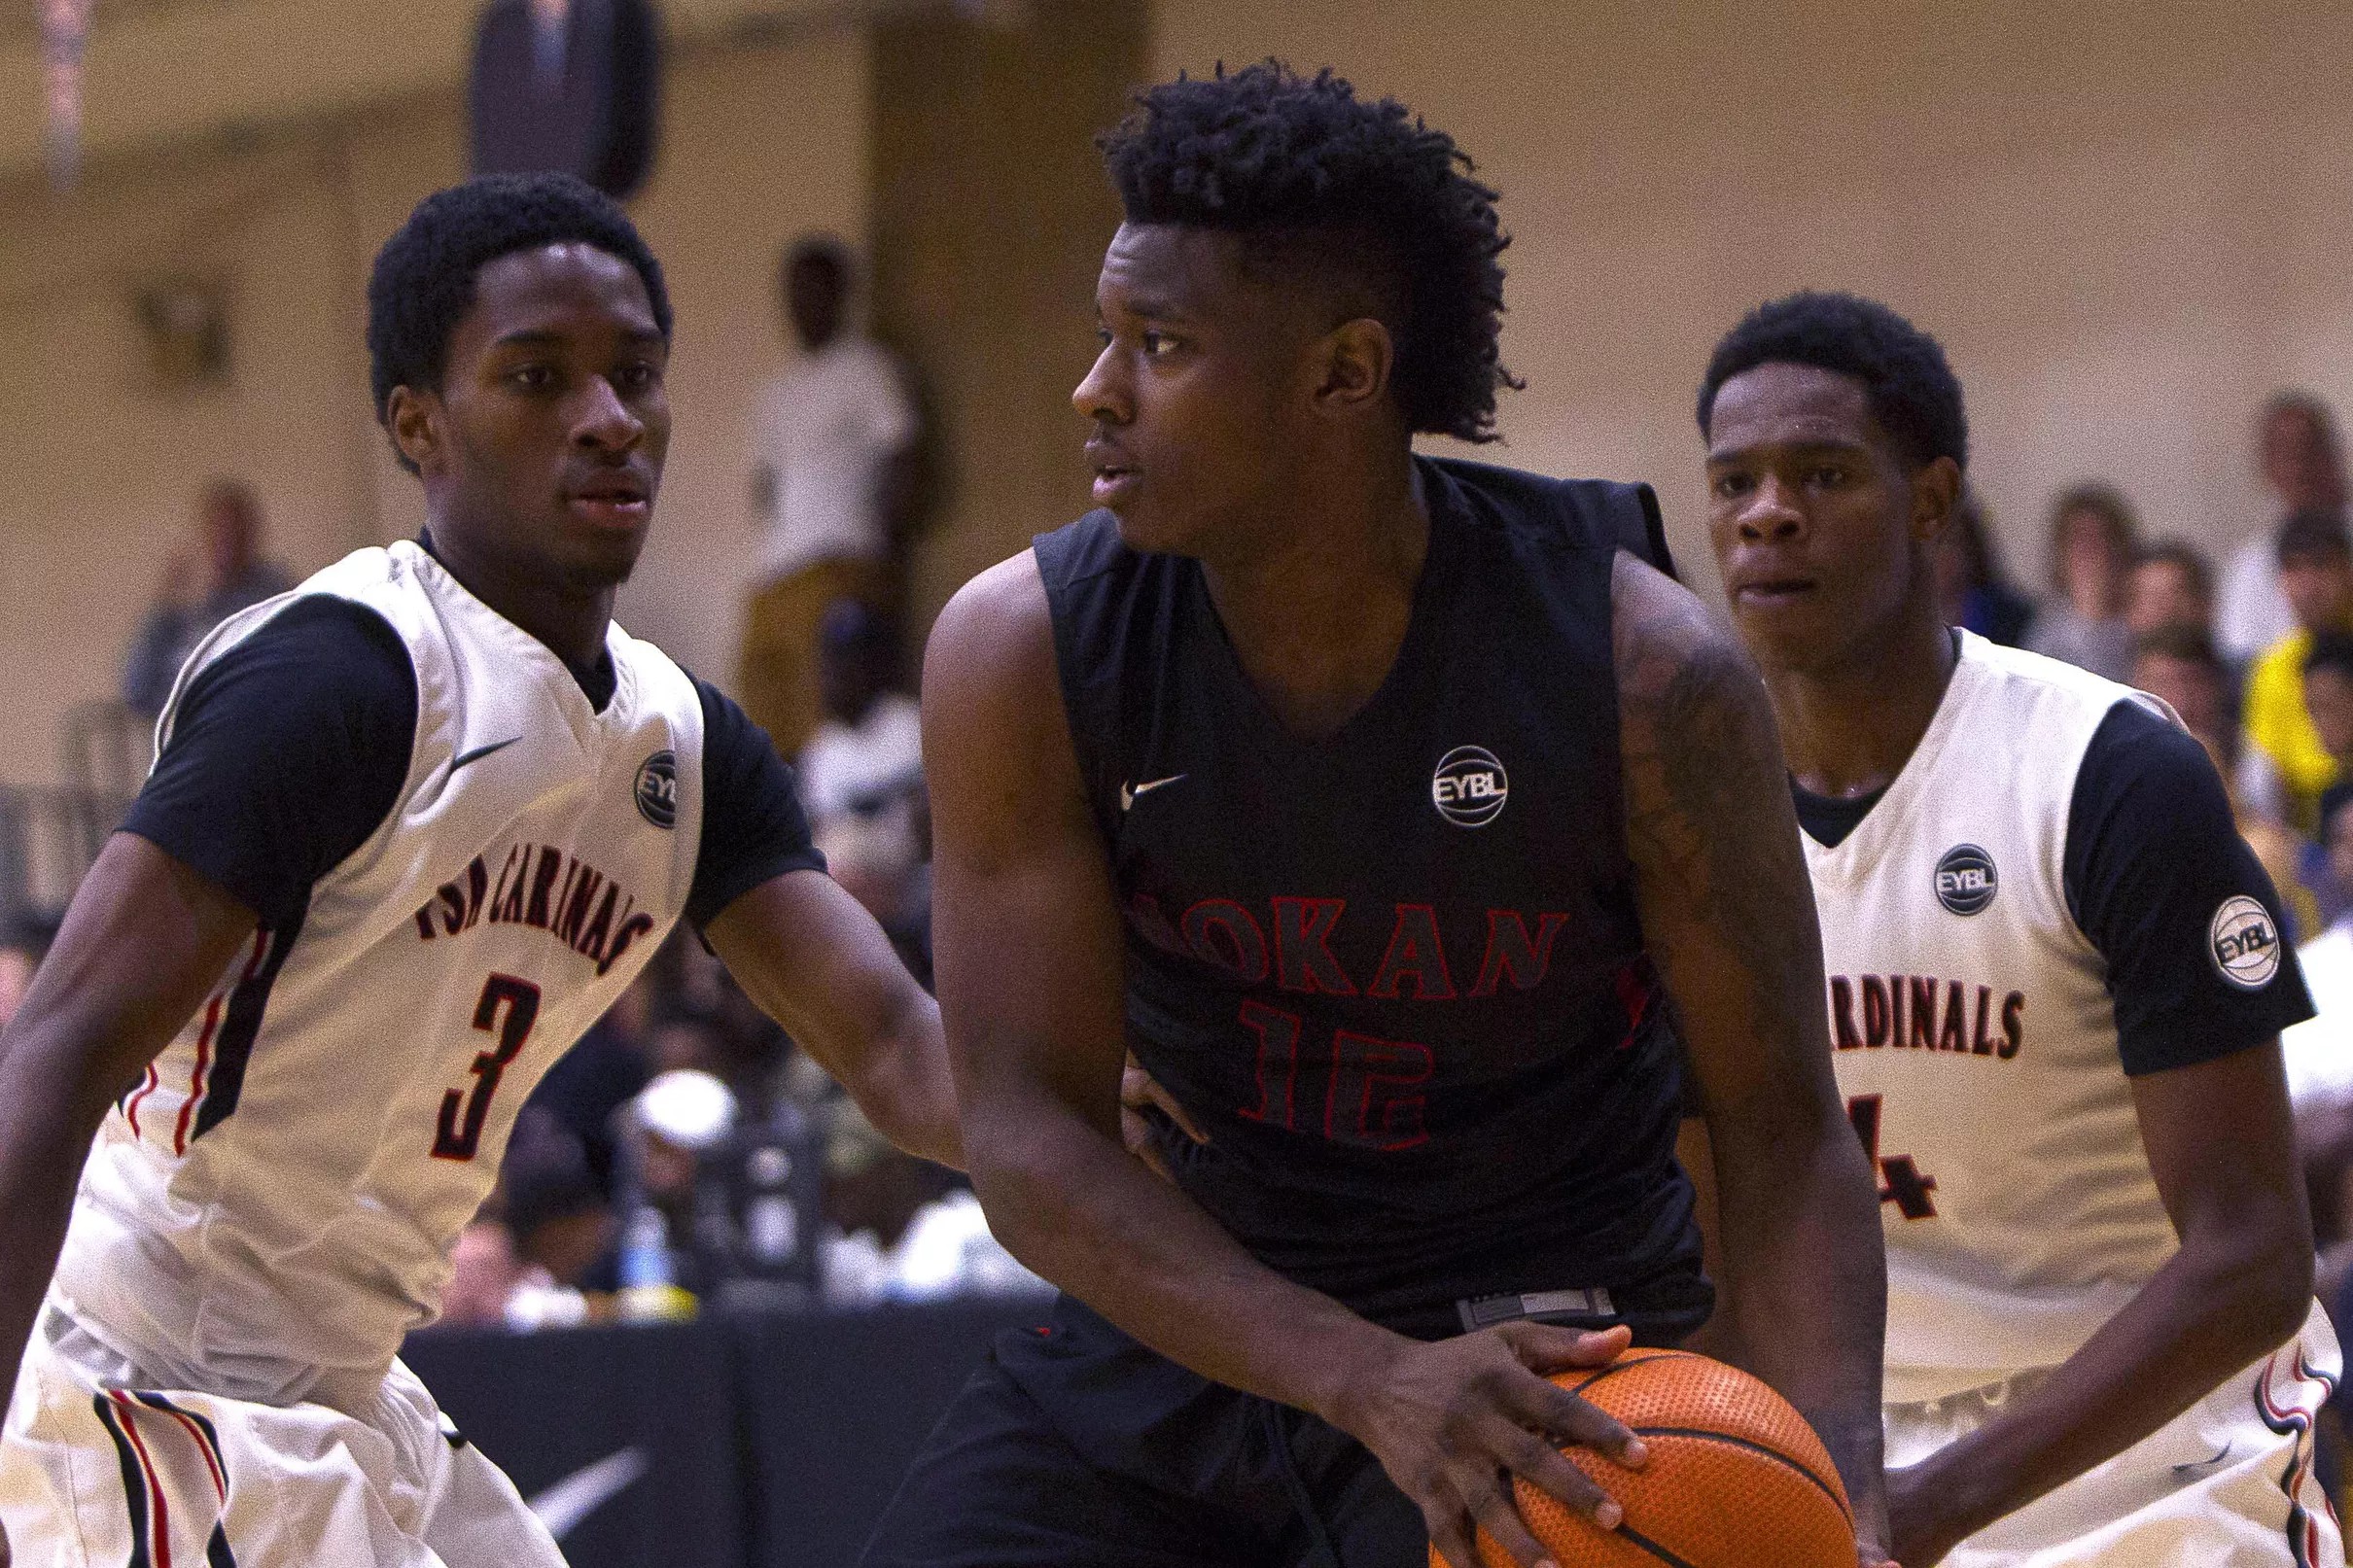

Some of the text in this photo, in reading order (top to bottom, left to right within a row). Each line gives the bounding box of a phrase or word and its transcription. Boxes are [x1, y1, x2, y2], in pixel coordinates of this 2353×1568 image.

[1433, 772, 1507, 802] EYBL
[1935, 868, 1995, 891] EYBL
[2216, 922, 2276, 964] EYBL
[1830, 973, 2026, 1060] RDINALS
[430, 972, 542, 1162] 3
[1238, 999, 1436, 1152] 12
